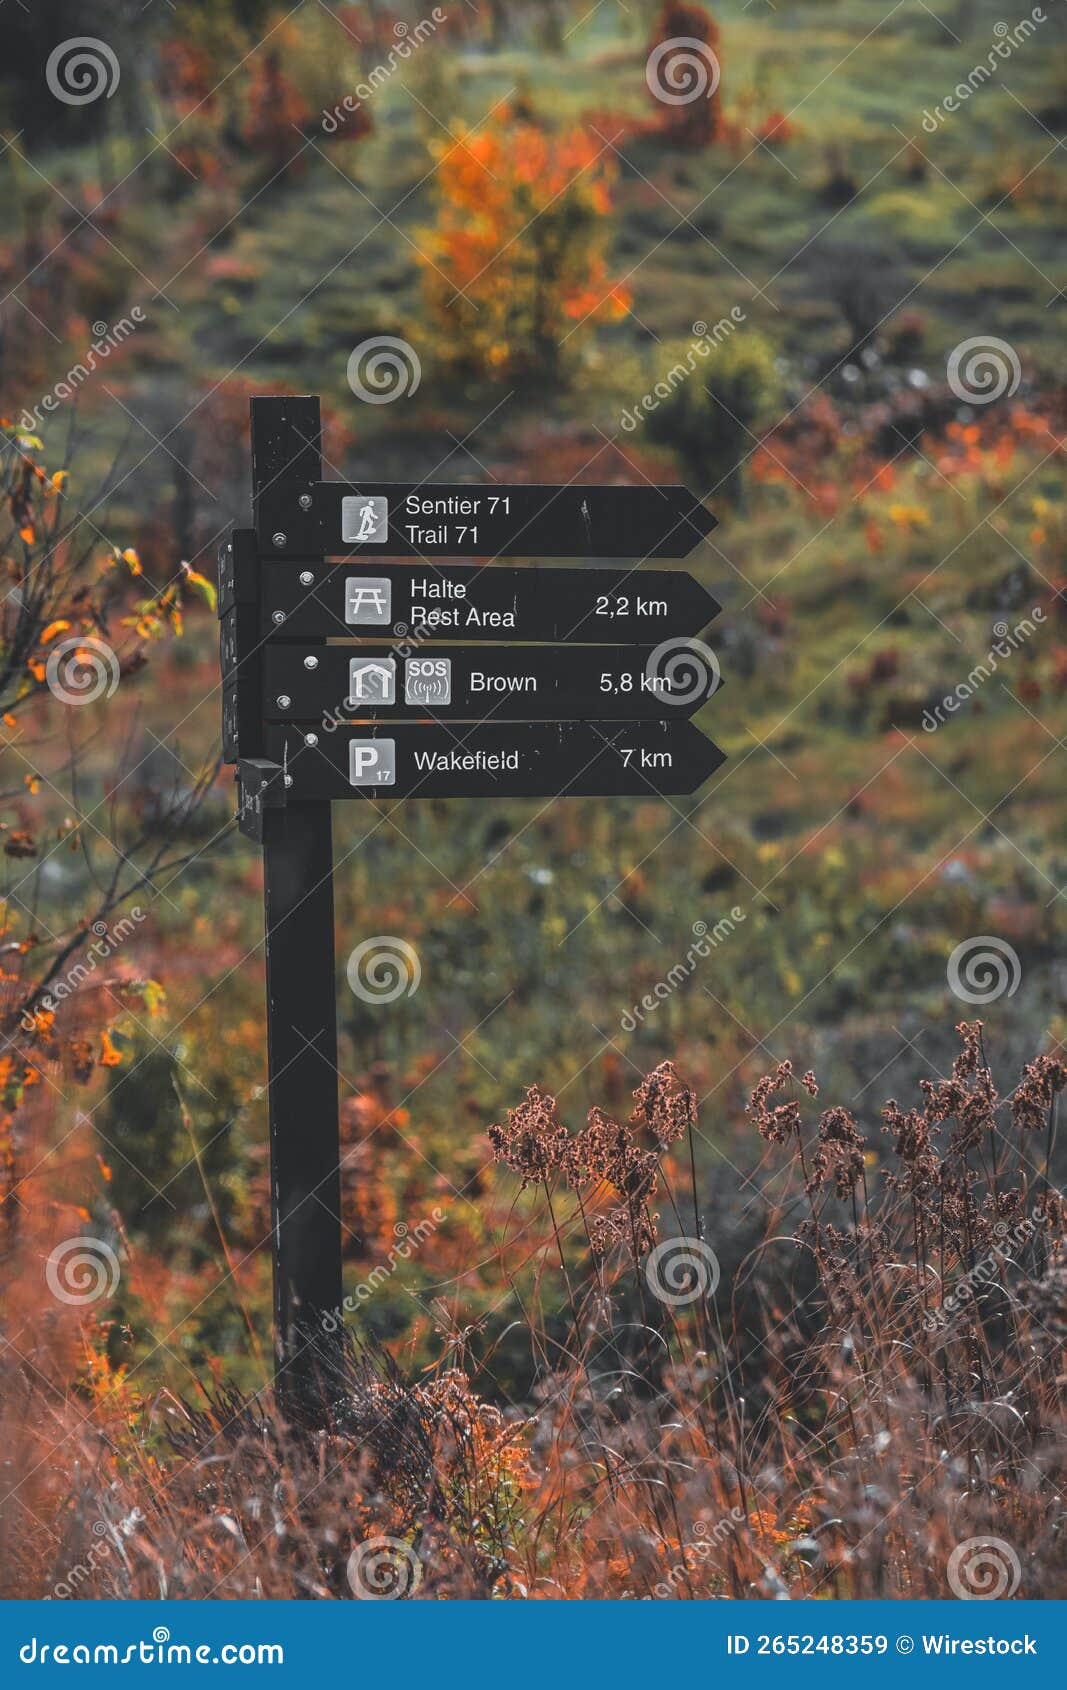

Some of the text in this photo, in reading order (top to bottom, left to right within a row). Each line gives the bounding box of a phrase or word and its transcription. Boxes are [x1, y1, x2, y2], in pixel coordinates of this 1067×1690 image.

[405, 496, 511, 515] Sentier 71
[405, 525, 479, 544] Trail 71
[410, 579, 467, 599] Halte
[410, 606, 516, 628] Rest Area
[595, 597, 668, 619] 2,2 km
[408, 661, 448, 677] SOS
[470, 673, 537, 692] Brown
[599, 673, 672, 696] 5,8 km
[355, 747, 391, 781] P 17
[413, 750, 519, 770] Wakefield
[620, 749, 673, 768] 7 km
